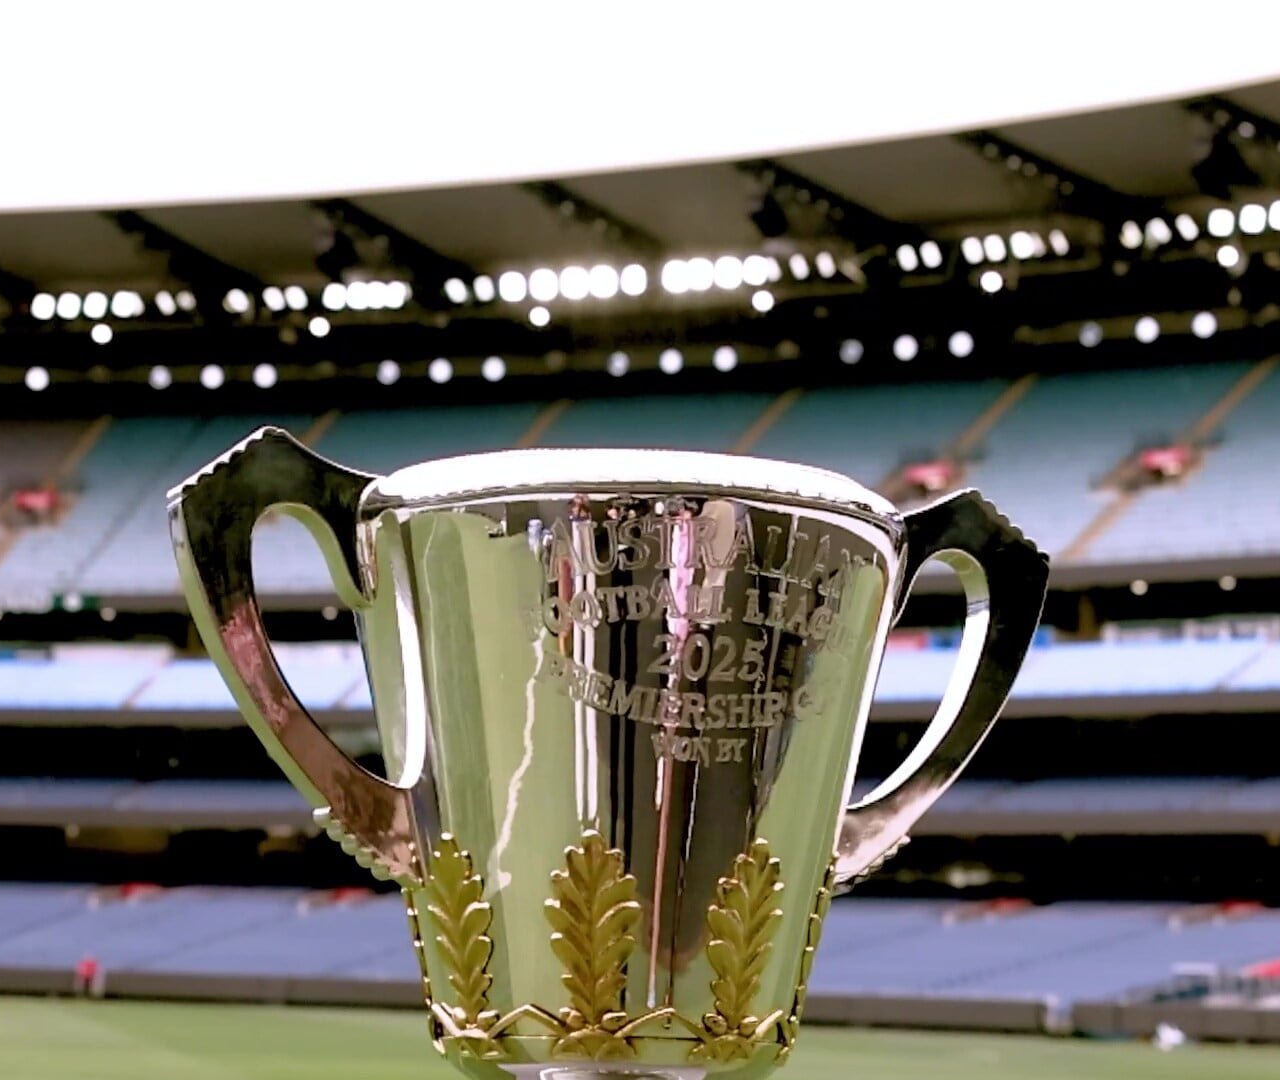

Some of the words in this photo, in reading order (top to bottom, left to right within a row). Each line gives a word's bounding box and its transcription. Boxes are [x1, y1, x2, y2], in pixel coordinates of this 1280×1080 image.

[523, 570, 733, 638] OOTBALL
[742, 587, 850, 652] LEAG
[646, 632, 767, 683] 2025
[545, 652, 788, 730] EMIERSHIP
[715, 737, 748, 764] BY
